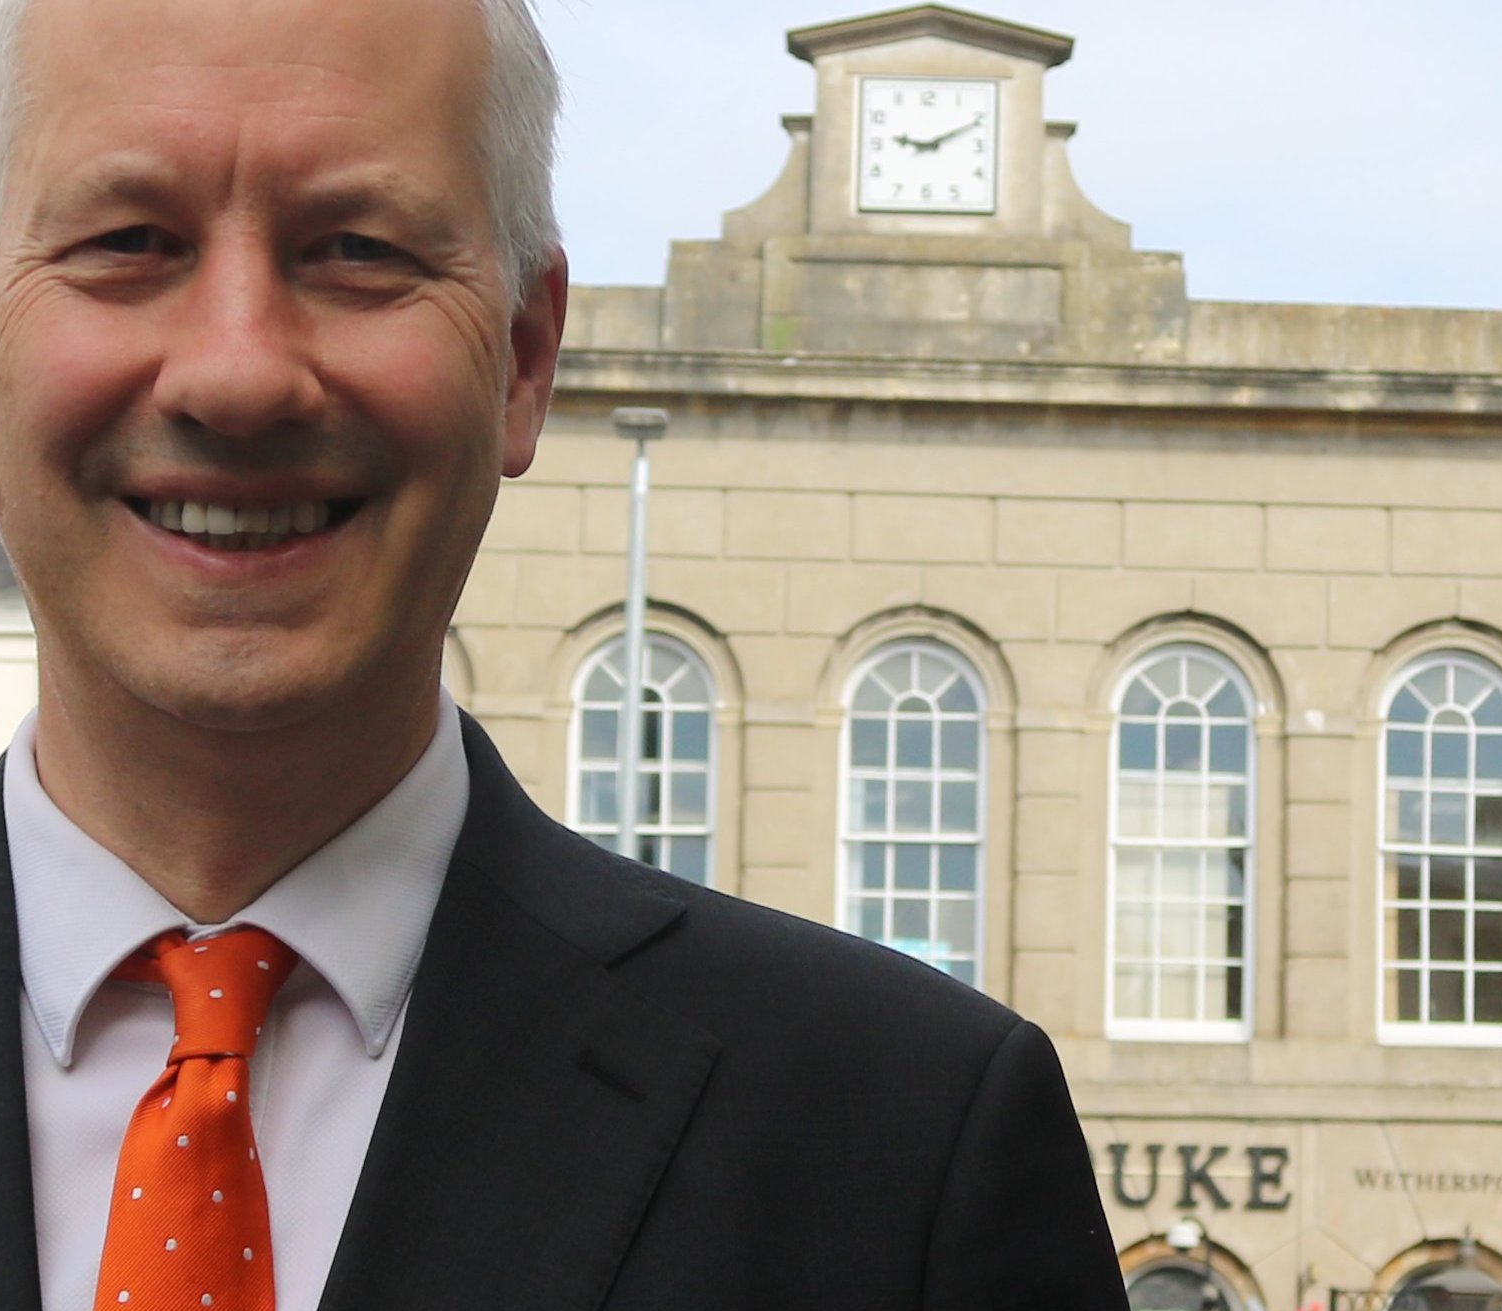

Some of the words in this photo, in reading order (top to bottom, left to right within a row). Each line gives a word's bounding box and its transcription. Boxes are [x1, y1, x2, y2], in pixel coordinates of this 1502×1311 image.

[920, 89, 937, 106] 12
[869, 108, 886, 125] 10
[972, 137, 984, 154] 3
[891, 182, 904, 199] 7
[948, 184, 961, 201] 5
[1087, 1142, 1294, 1211] UKE
